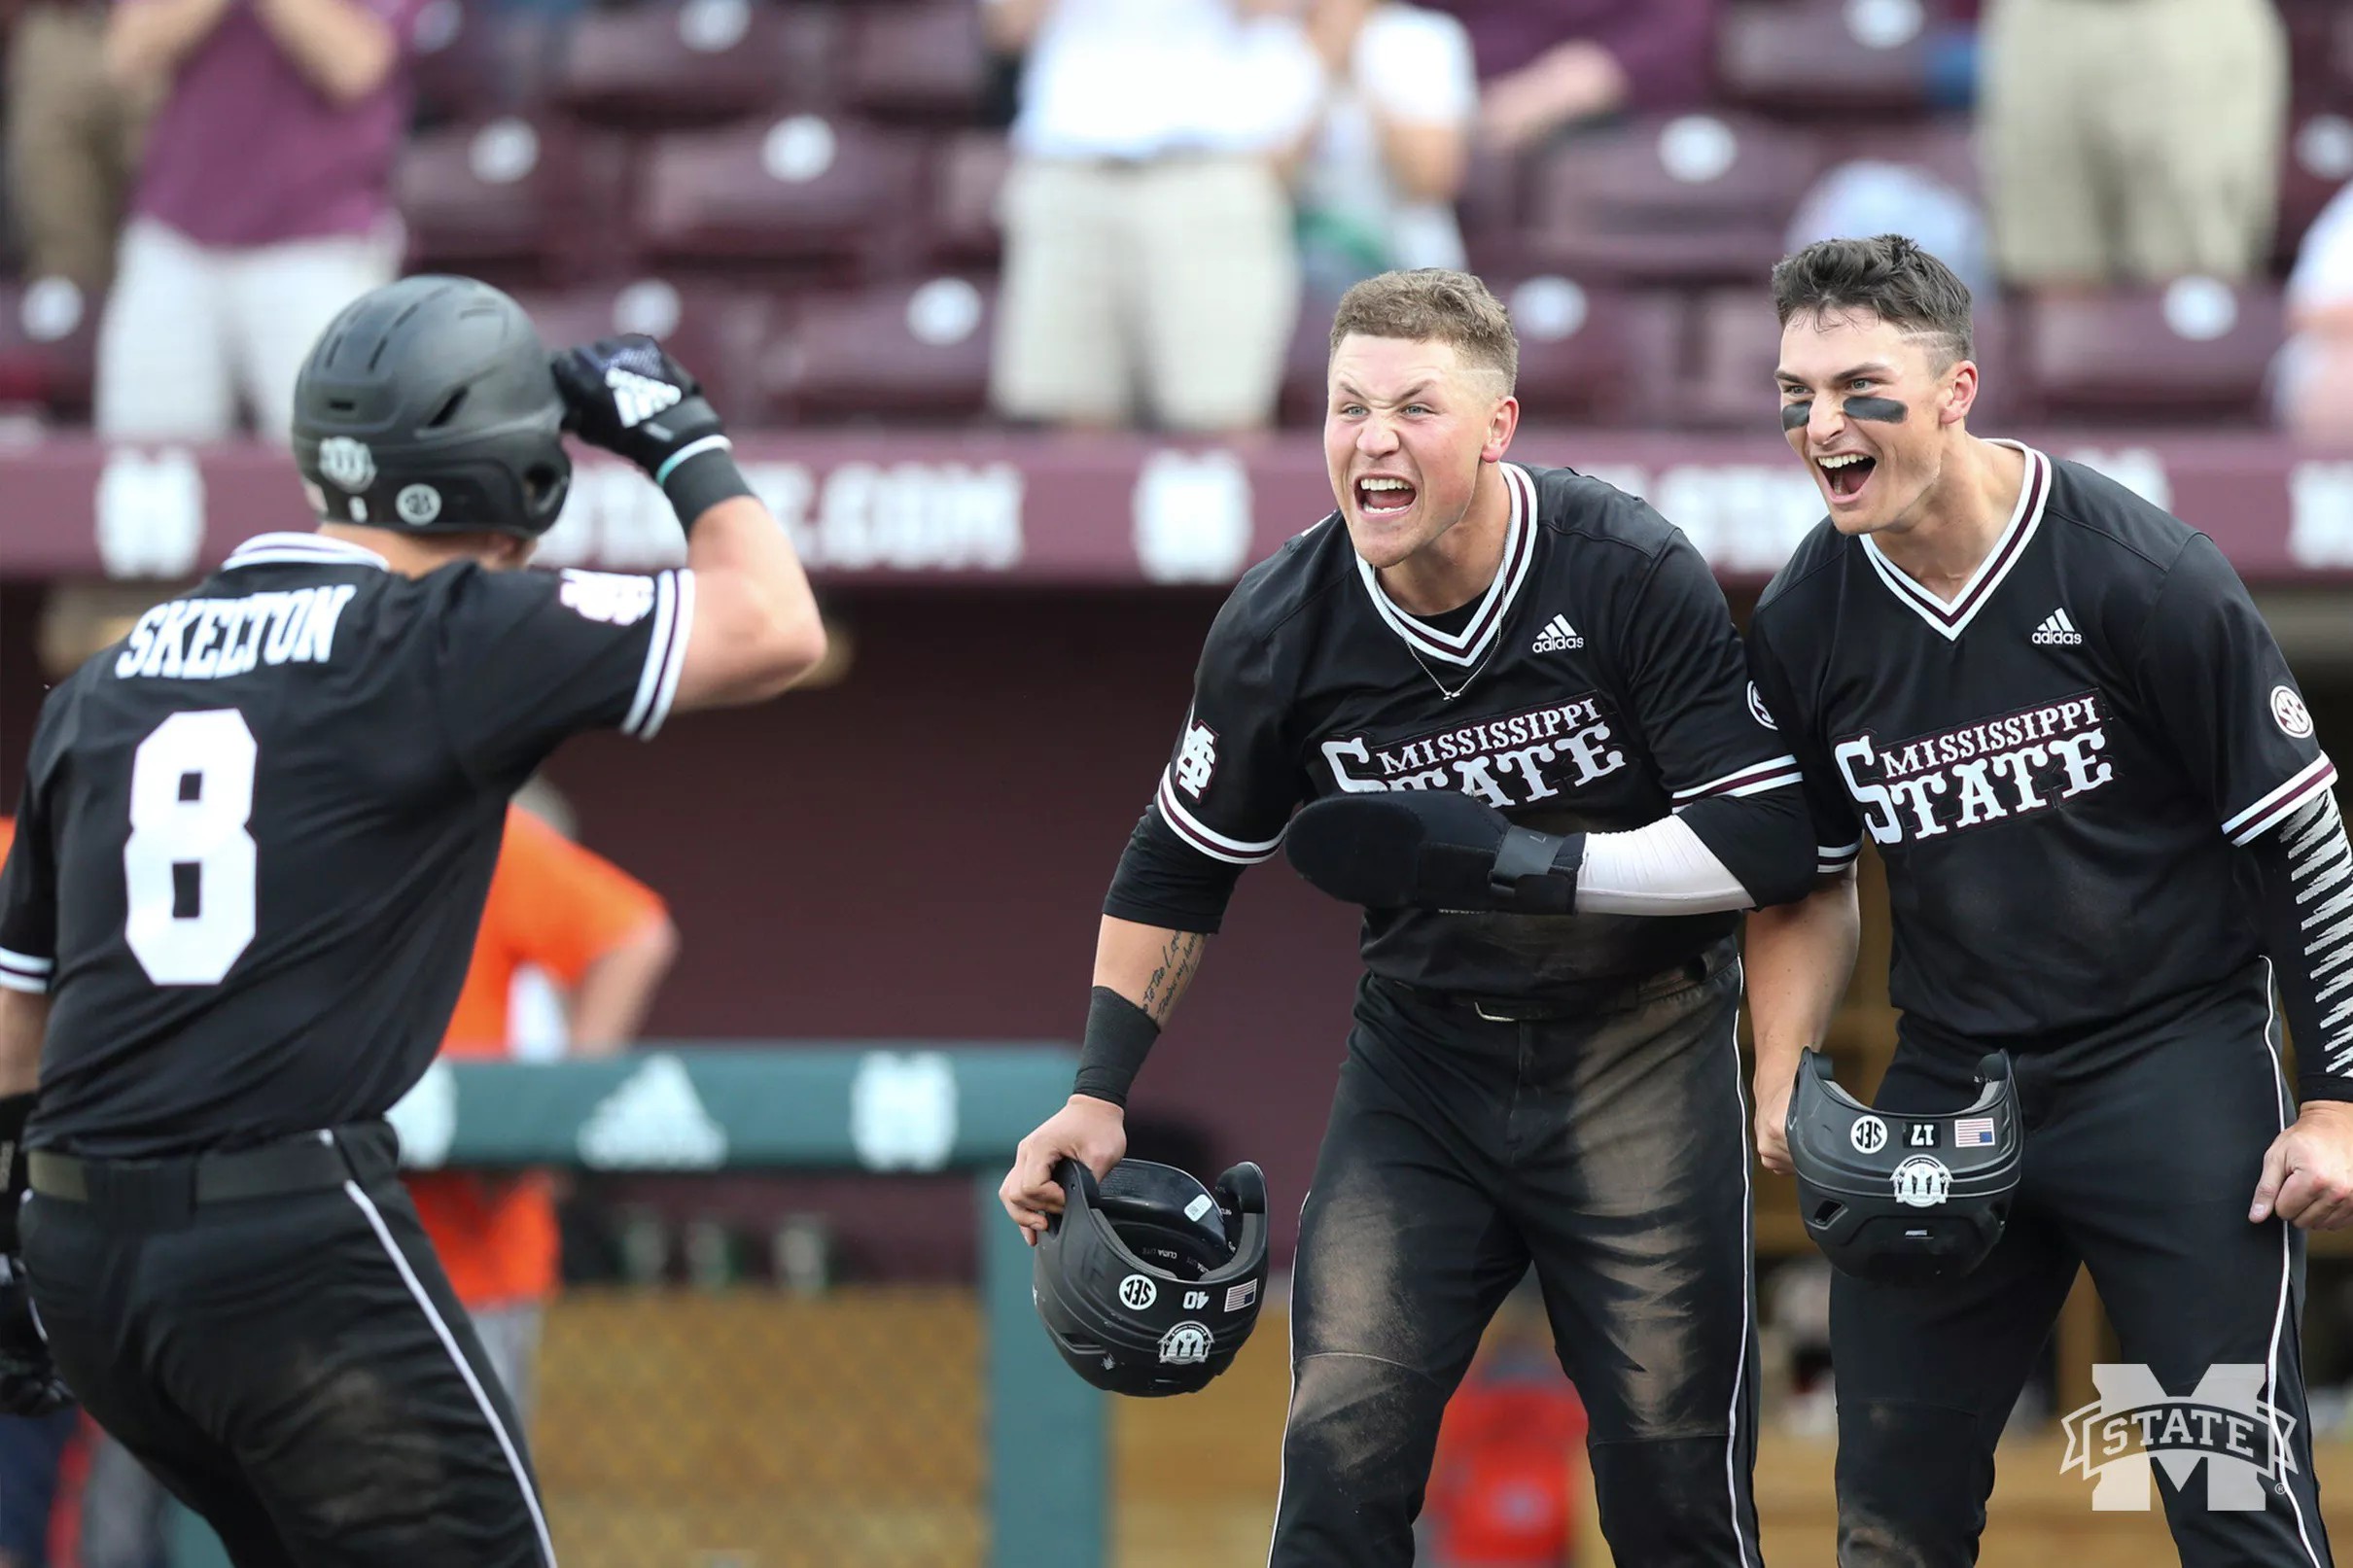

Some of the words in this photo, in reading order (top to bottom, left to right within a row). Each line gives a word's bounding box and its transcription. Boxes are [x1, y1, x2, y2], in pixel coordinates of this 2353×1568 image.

[116, 585, 357, 679] SKELTON
[1532, 633, 1585, 652] adidas
[2031, 630, 2083, 645] adidas
[1376, 697, 1602, 776] MISSISSIPPI
[1879, 696, 2101, 780] MISSISSIPPI
[1834, 725, 2114, 845] STATE
[124, 708, 258, 986] 8
[1854, 1119, 1883, 1150] SEC
[1911, 1124, 1934, 1147] 17
[1122, 1278, 1153, 1306] SEC
[1182, 1290, 1210, 1310] 40
